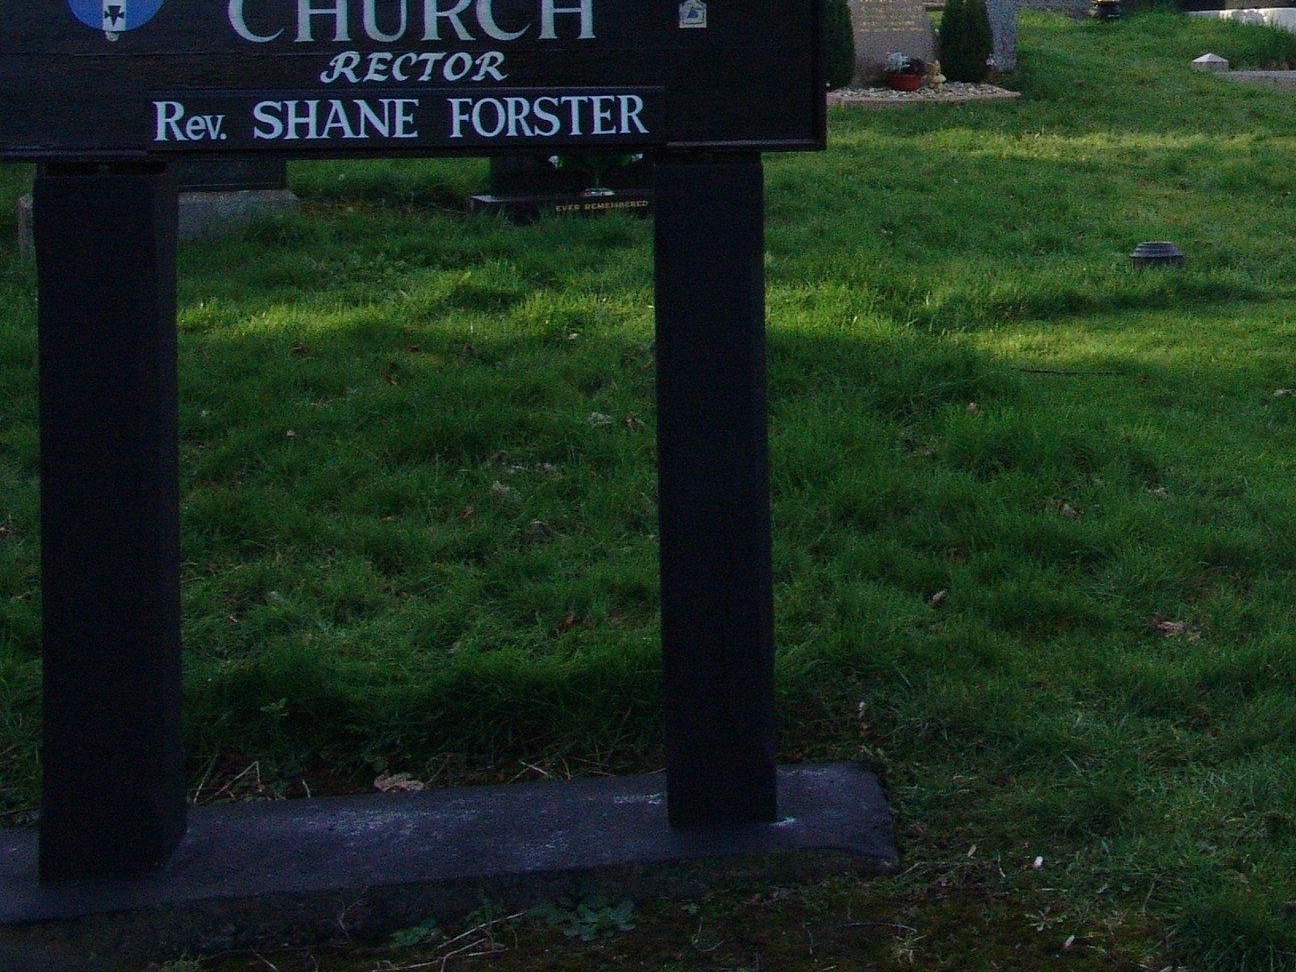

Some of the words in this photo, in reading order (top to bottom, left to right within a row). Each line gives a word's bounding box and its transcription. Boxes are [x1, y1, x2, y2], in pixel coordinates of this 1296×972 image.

[320, 50, 508, 84] RECTOR
[153, 100, 228, 141] Rev.
[252, 98, 420, 140] SHANE
[448, 94, 649, 138] FORSTER
